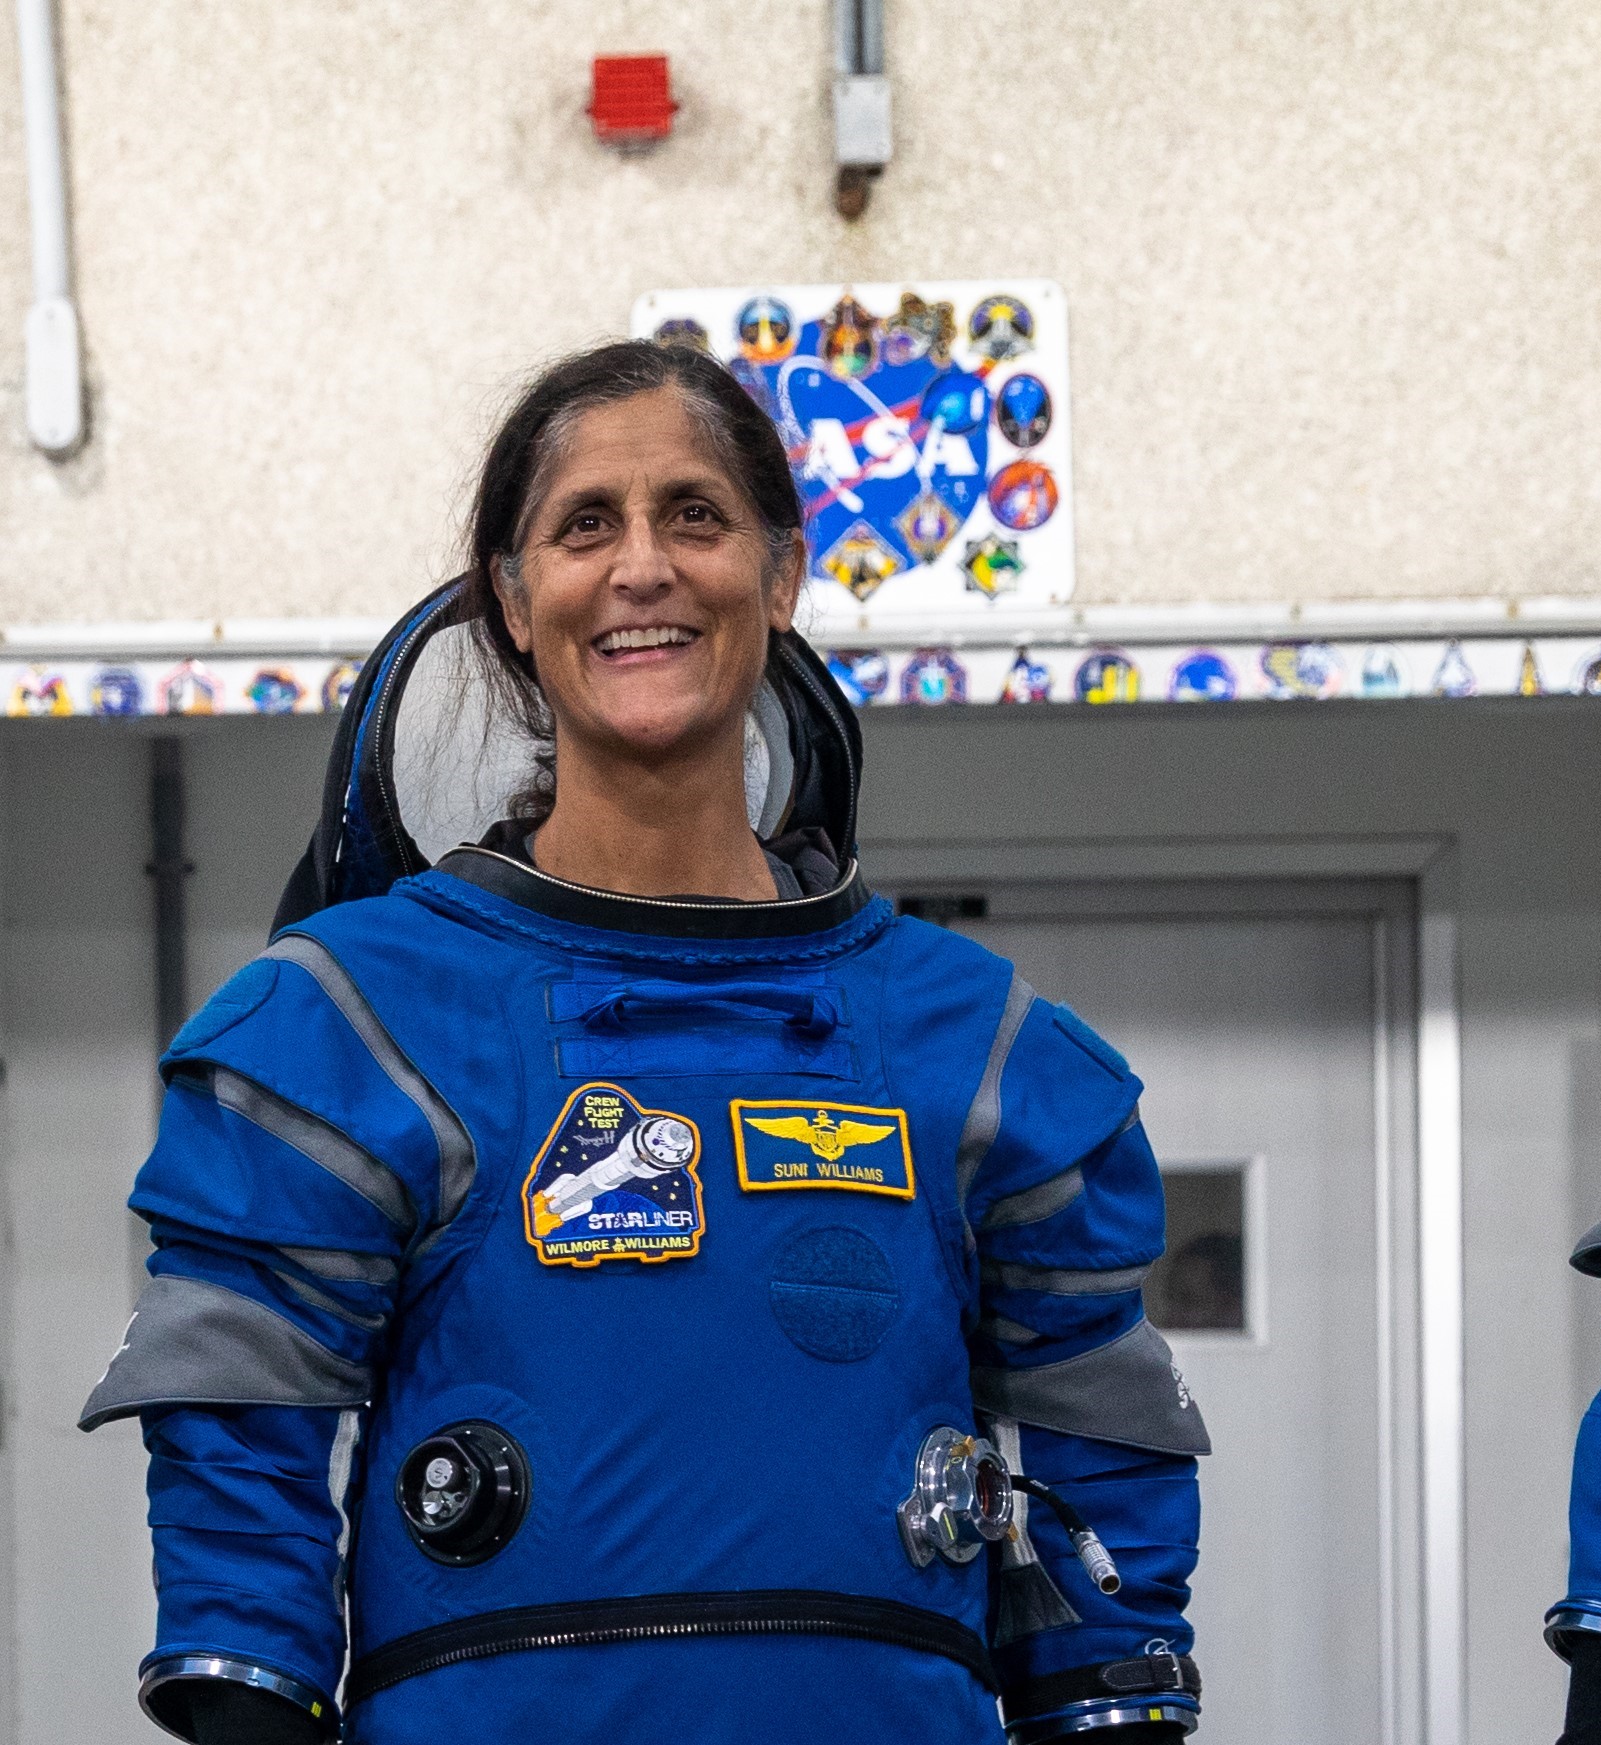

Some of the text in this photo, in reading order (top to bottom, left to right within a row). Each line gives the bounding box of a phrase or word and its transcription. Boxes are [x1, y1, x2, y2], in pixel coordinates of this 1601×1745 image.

[803, 416, 980, 482] ASA
[584, 1095, 621, 1107] CREW
[583, 1106, 625, 1118] FLIGHT
[587, 1117, 621, 1129] TEST
[773, 1162, 884, 1183] SUNI WILLIAMS
[587, 1210, 694, 1230] STARLINER
[546, 1236, 692, 1256] WILMORE WILLIAMS
